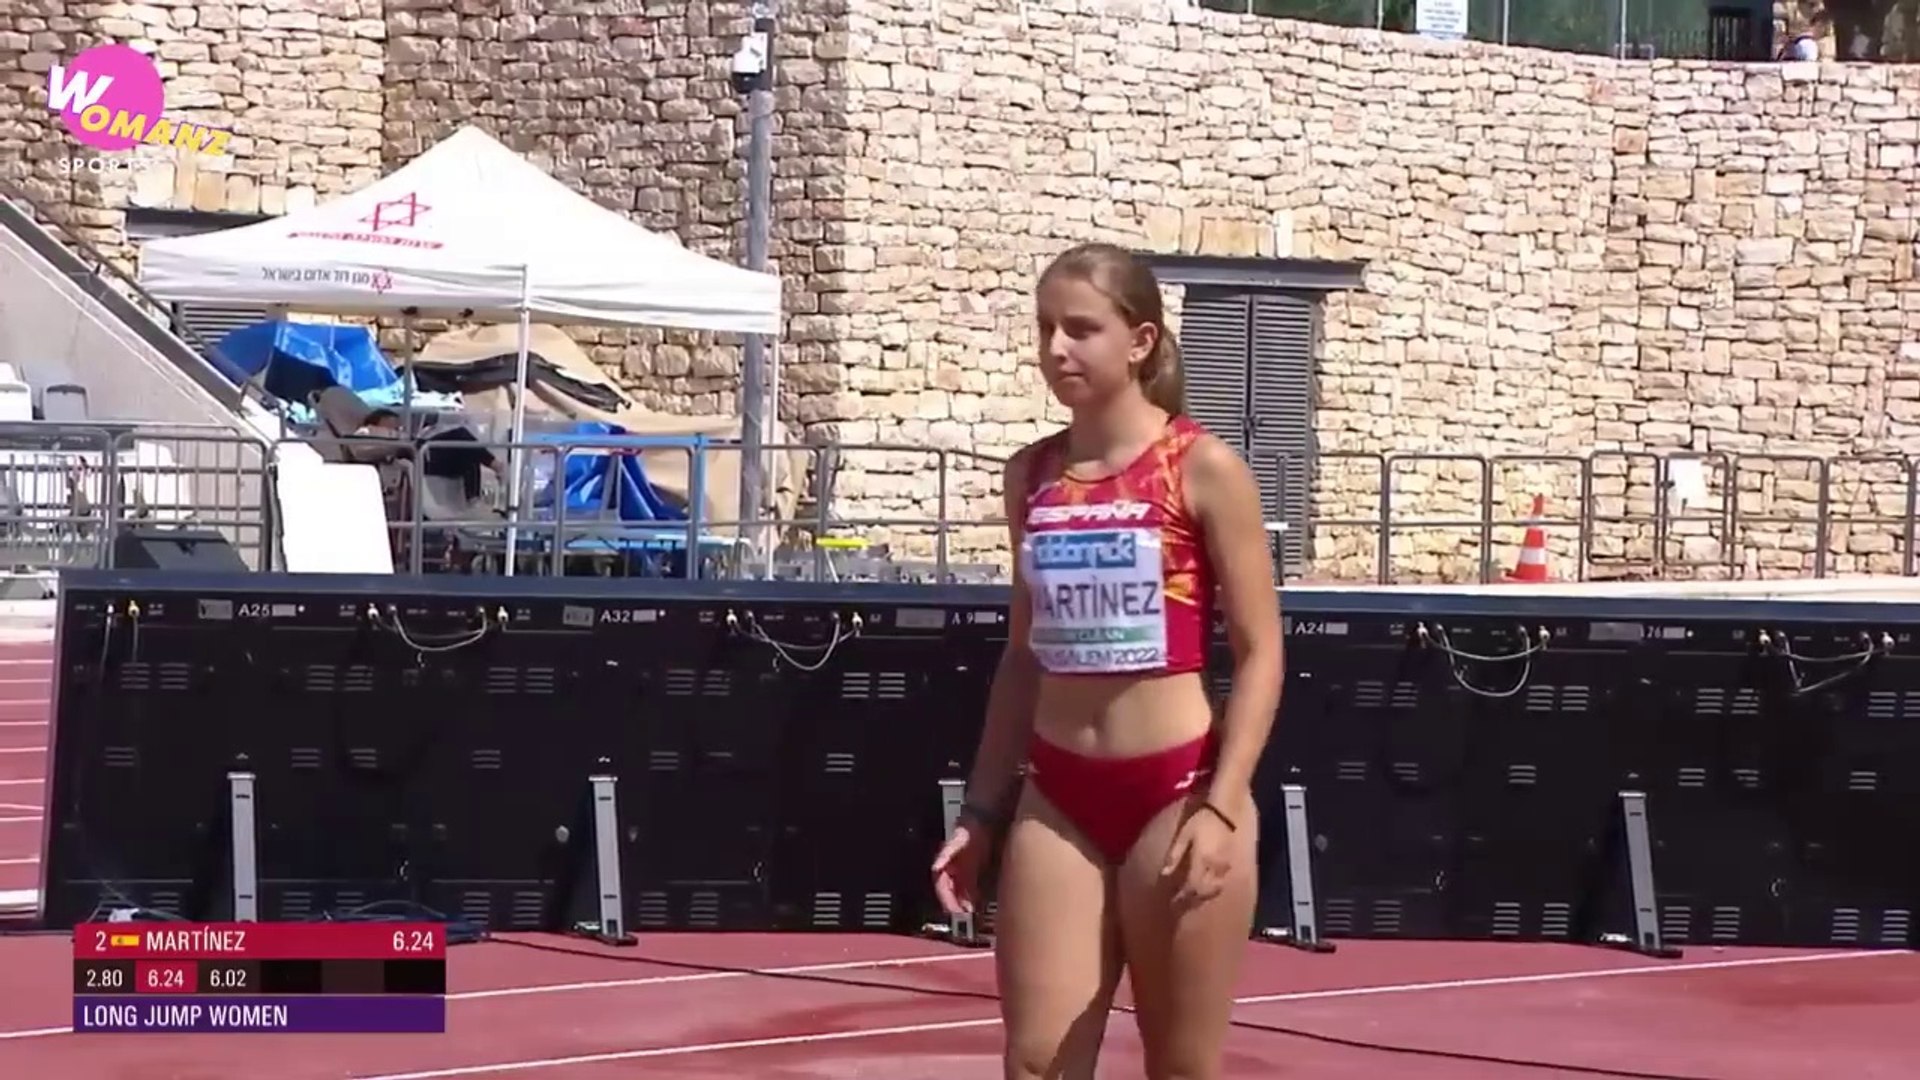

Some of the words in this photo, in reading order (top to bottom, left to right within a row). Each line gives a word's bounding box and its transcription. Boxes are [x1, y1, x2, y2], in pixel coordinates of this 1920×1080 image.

[1027, 500, 1152, 525] ESPAÑA
[238, 604, 270, 617] A25
[600, 610, 630, 623] A32
[1295, 621, 1324, 635] A24
[1115, 647, 1160, 665] 2022
